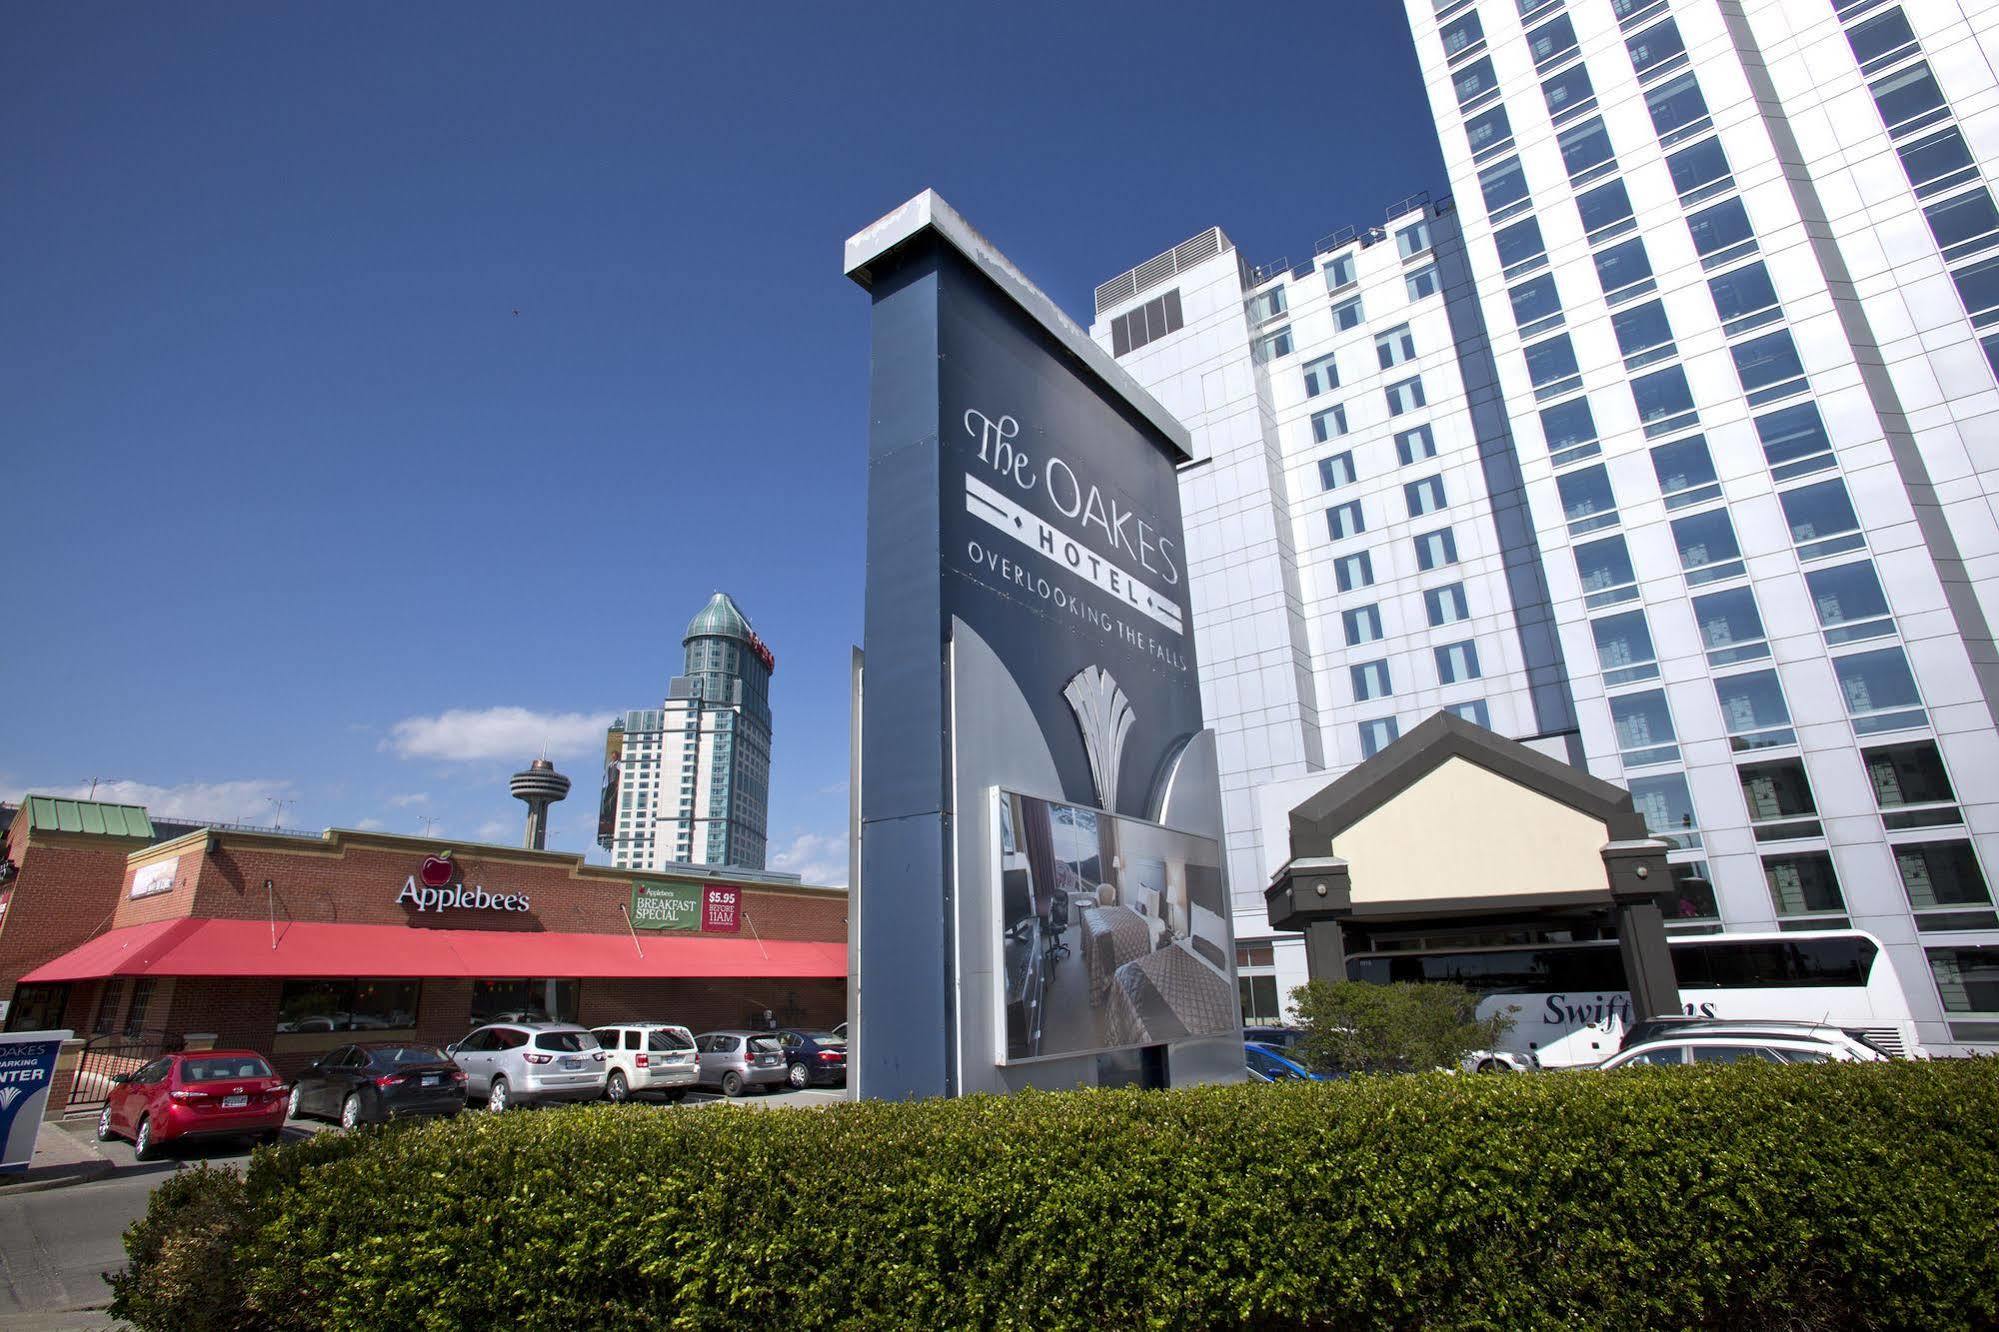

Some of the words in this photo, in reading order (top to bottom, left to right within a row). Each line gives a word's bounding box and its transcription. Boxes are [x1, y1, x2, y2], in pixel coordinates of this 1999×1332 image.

[964, 408, 1036, 490] The
[1045, 457, 1179, 585] OAKES
[1038, 525, 1138, 605] HOTEL
[968, 541, 1112, 632] OVERLOOKING
[1116, 620, 1145, 650] THE
[1150, 638, 1187, 672] FALLS
[395, 875, 530, 913] Applebee's
[708, 890, 736, 904] $5.95
[637, 897, 697, 912] BREAKFAST
[709, 904, 735, 913] BEFORE
[636, 908, 680, 921] SPECIAL
[709, 911, 734, 922] 11AM
[0, 1058, 38, 1069] ARKING
